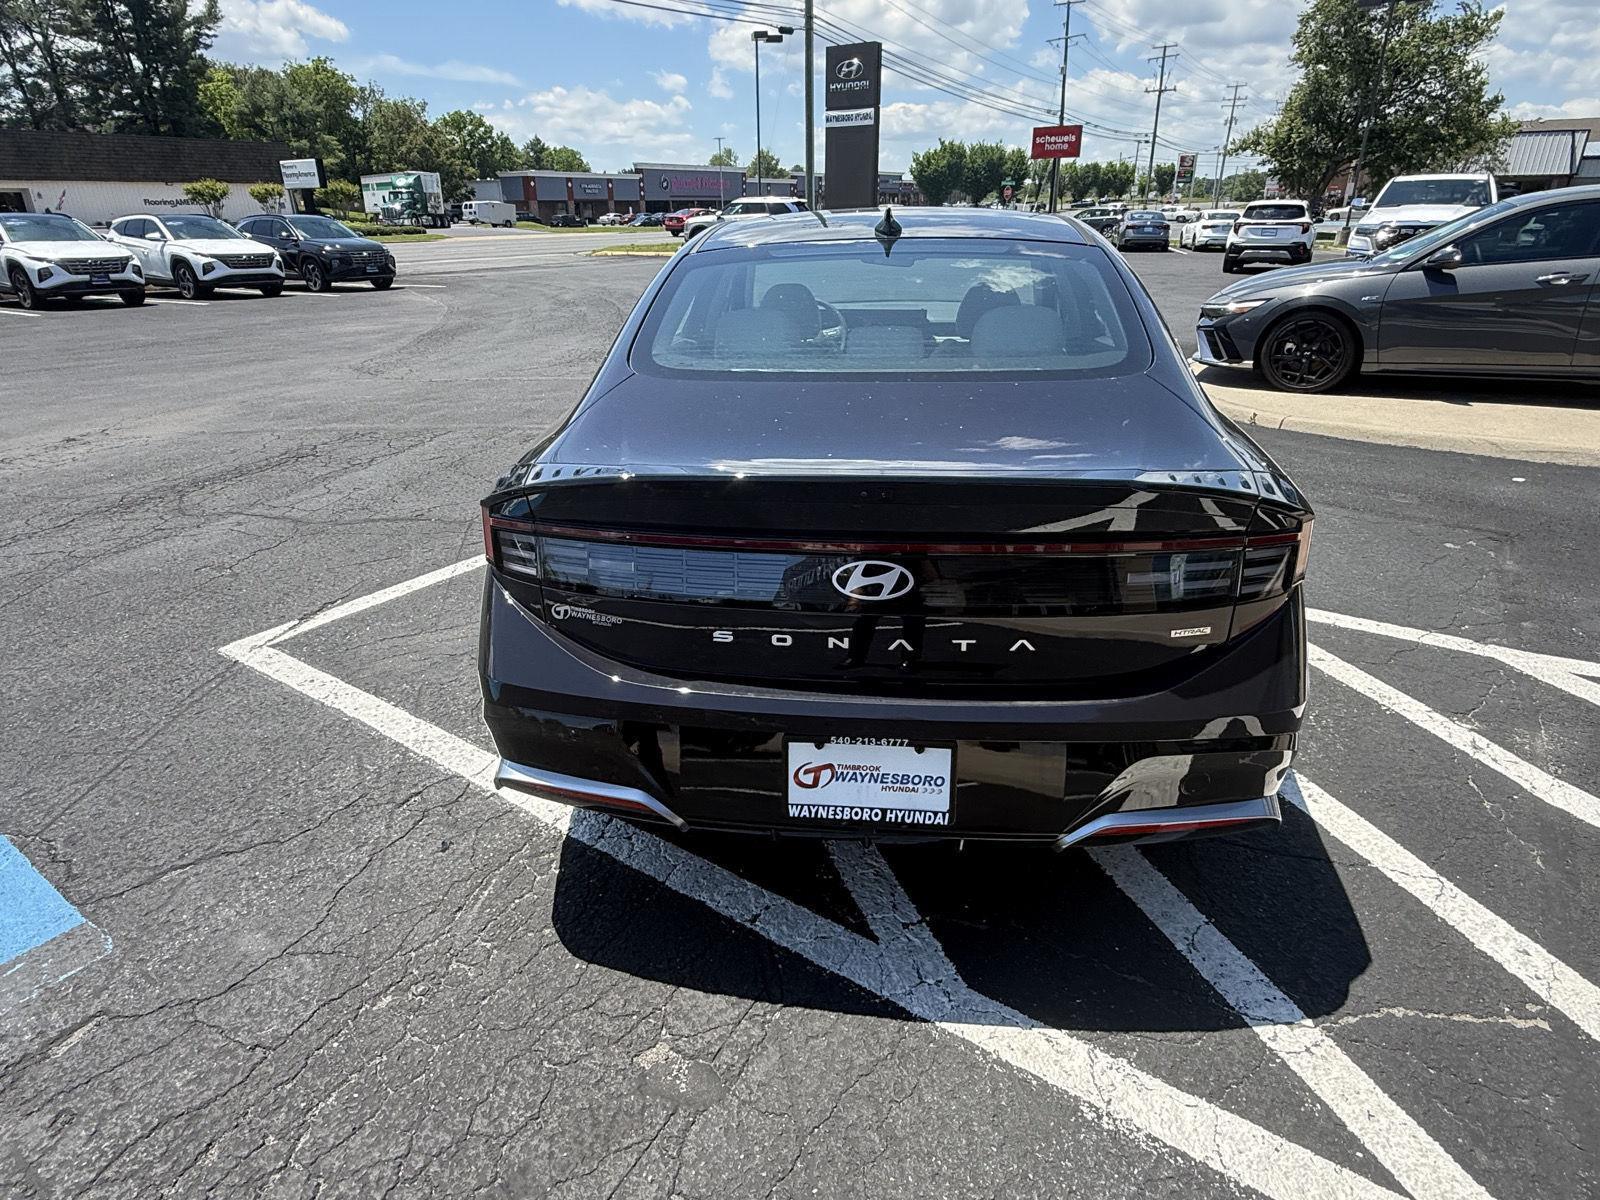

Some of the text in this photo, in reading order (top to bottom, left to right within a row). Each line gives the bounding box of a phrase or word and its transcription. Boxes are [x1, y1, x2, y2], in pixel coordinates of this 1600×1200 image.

[829, 80, 870, 92] HYUNDAI
[1035, 133, 1076, 143] schewels
[1044, 142, 1069, 150] home
[570, 610, 622, 624] WAYNESBORO
[712, 630, 1036, 652] SONATA
[830, 736, 909, 747] 540-213-6777
[836, 763, 881, 772] TIMBROOK
[835, 771, 945, 787] WAYNESBORO
[880, 785, 919, 793] HYUNDAI
[788, 804, 949, 825] WAYNESBORO HYUNDAI
